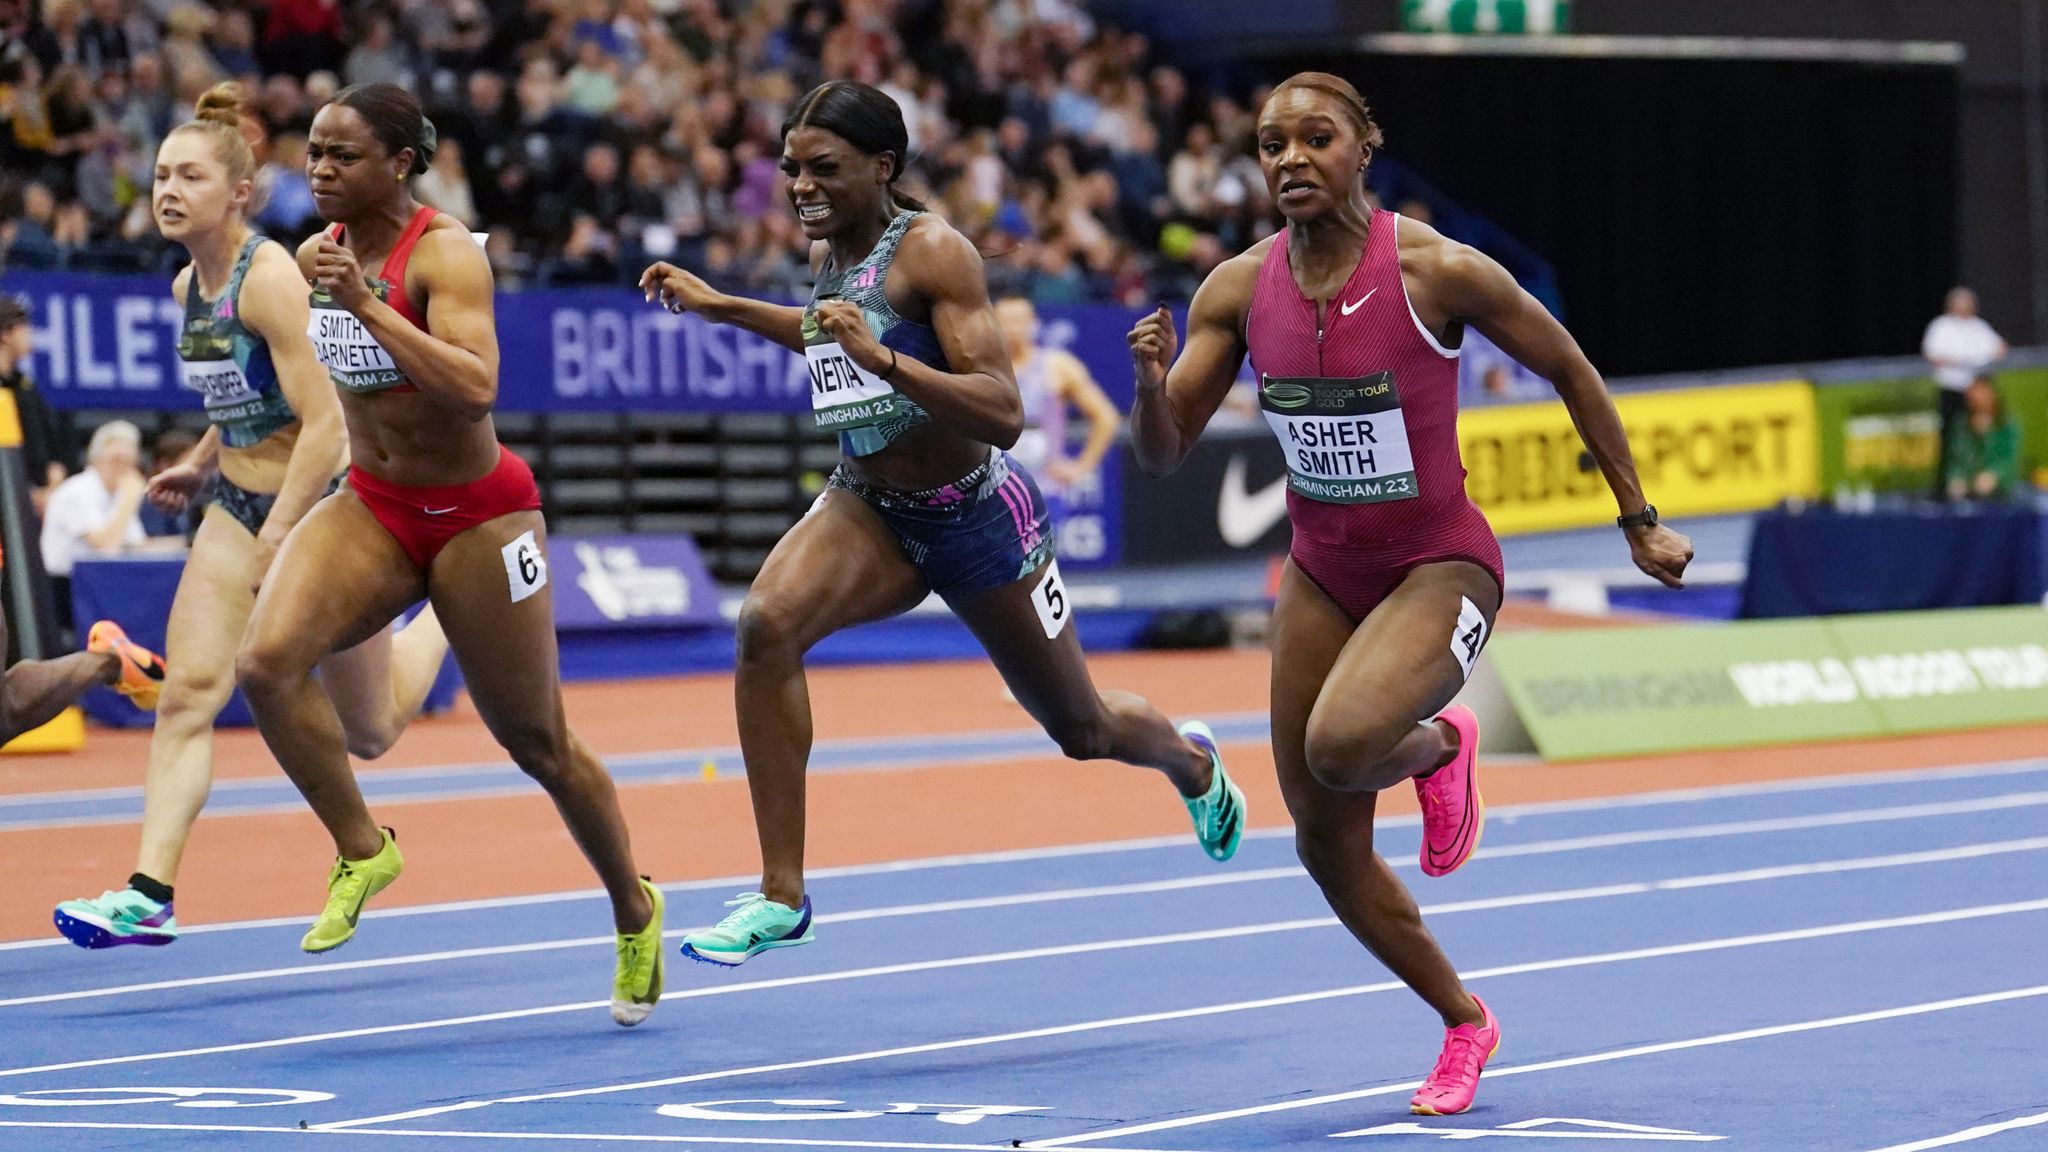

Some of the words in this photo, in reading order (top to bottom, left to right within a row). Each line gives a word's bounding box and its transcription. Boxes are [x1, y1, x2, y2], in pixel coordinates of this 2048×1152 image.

[320, 315, 362, 340] SMITH
[380, 371, 399, 382] 23
[808, 355, 864, 395] NEITA
[1316, 398, 1345, 408] GOLD
[1357, 383, 1389, 398] TOUR
[873, 399, 894, 415] 23
[1288, 420, 1377, 448] ASHER
[1297, 448, 1377, 475] SMITH
[1292, 474, 1381, 498] BIRMINGHAM
[1385, 477, 1410, 494] 23
[518, 544, 538, 586] 6
[1044, 575, 1064, 620] 5
[1461, 621, 1482, 664] 4
